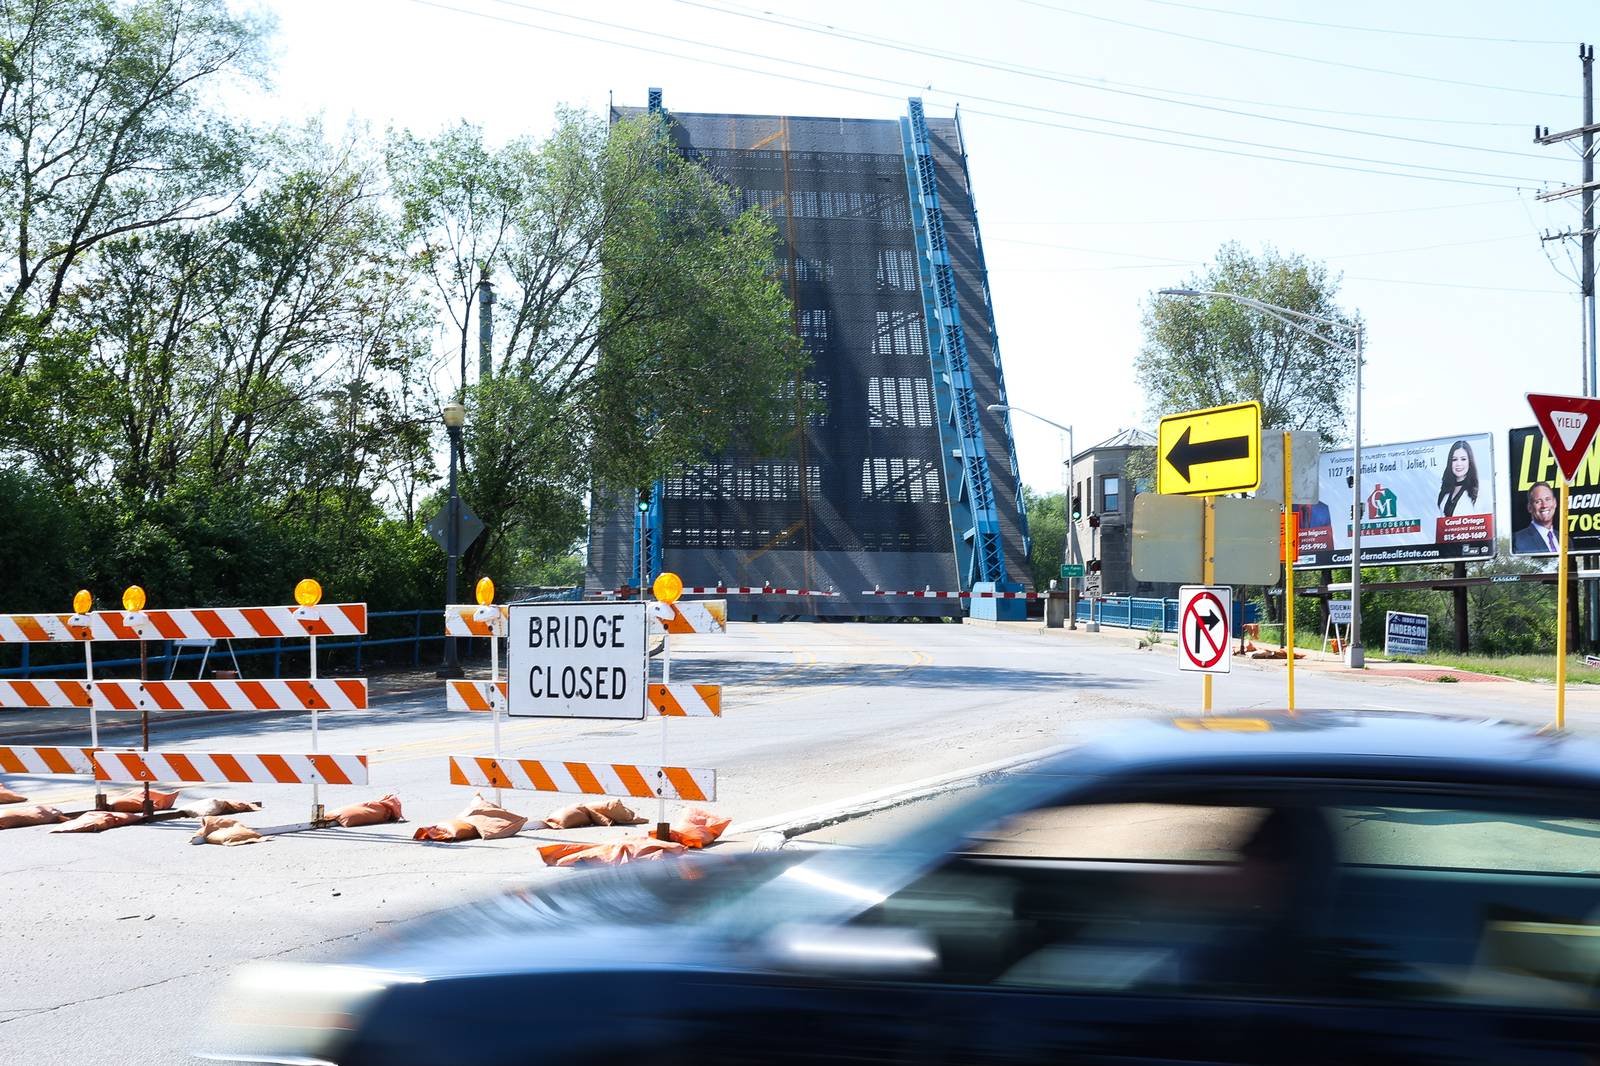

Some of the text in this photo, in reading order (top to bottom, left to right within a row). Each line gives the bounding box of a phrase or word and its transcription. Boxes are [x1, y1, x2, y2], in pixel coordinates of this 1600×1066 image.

[1557, 417, 1581, 429] YIELD
[1328, 457, 1437, 478] 1127 Plnfield Road Joliet, IL
[1567, 513, 1600, 532] 708
[1332, 550, 1440, 563] CasadernaRealEstate.com
[529, 615, 625, 648] BRIDGE
[1389, 623, 1426, 638] ANDERSON
[529, 665, 627, 699] CLOSED
